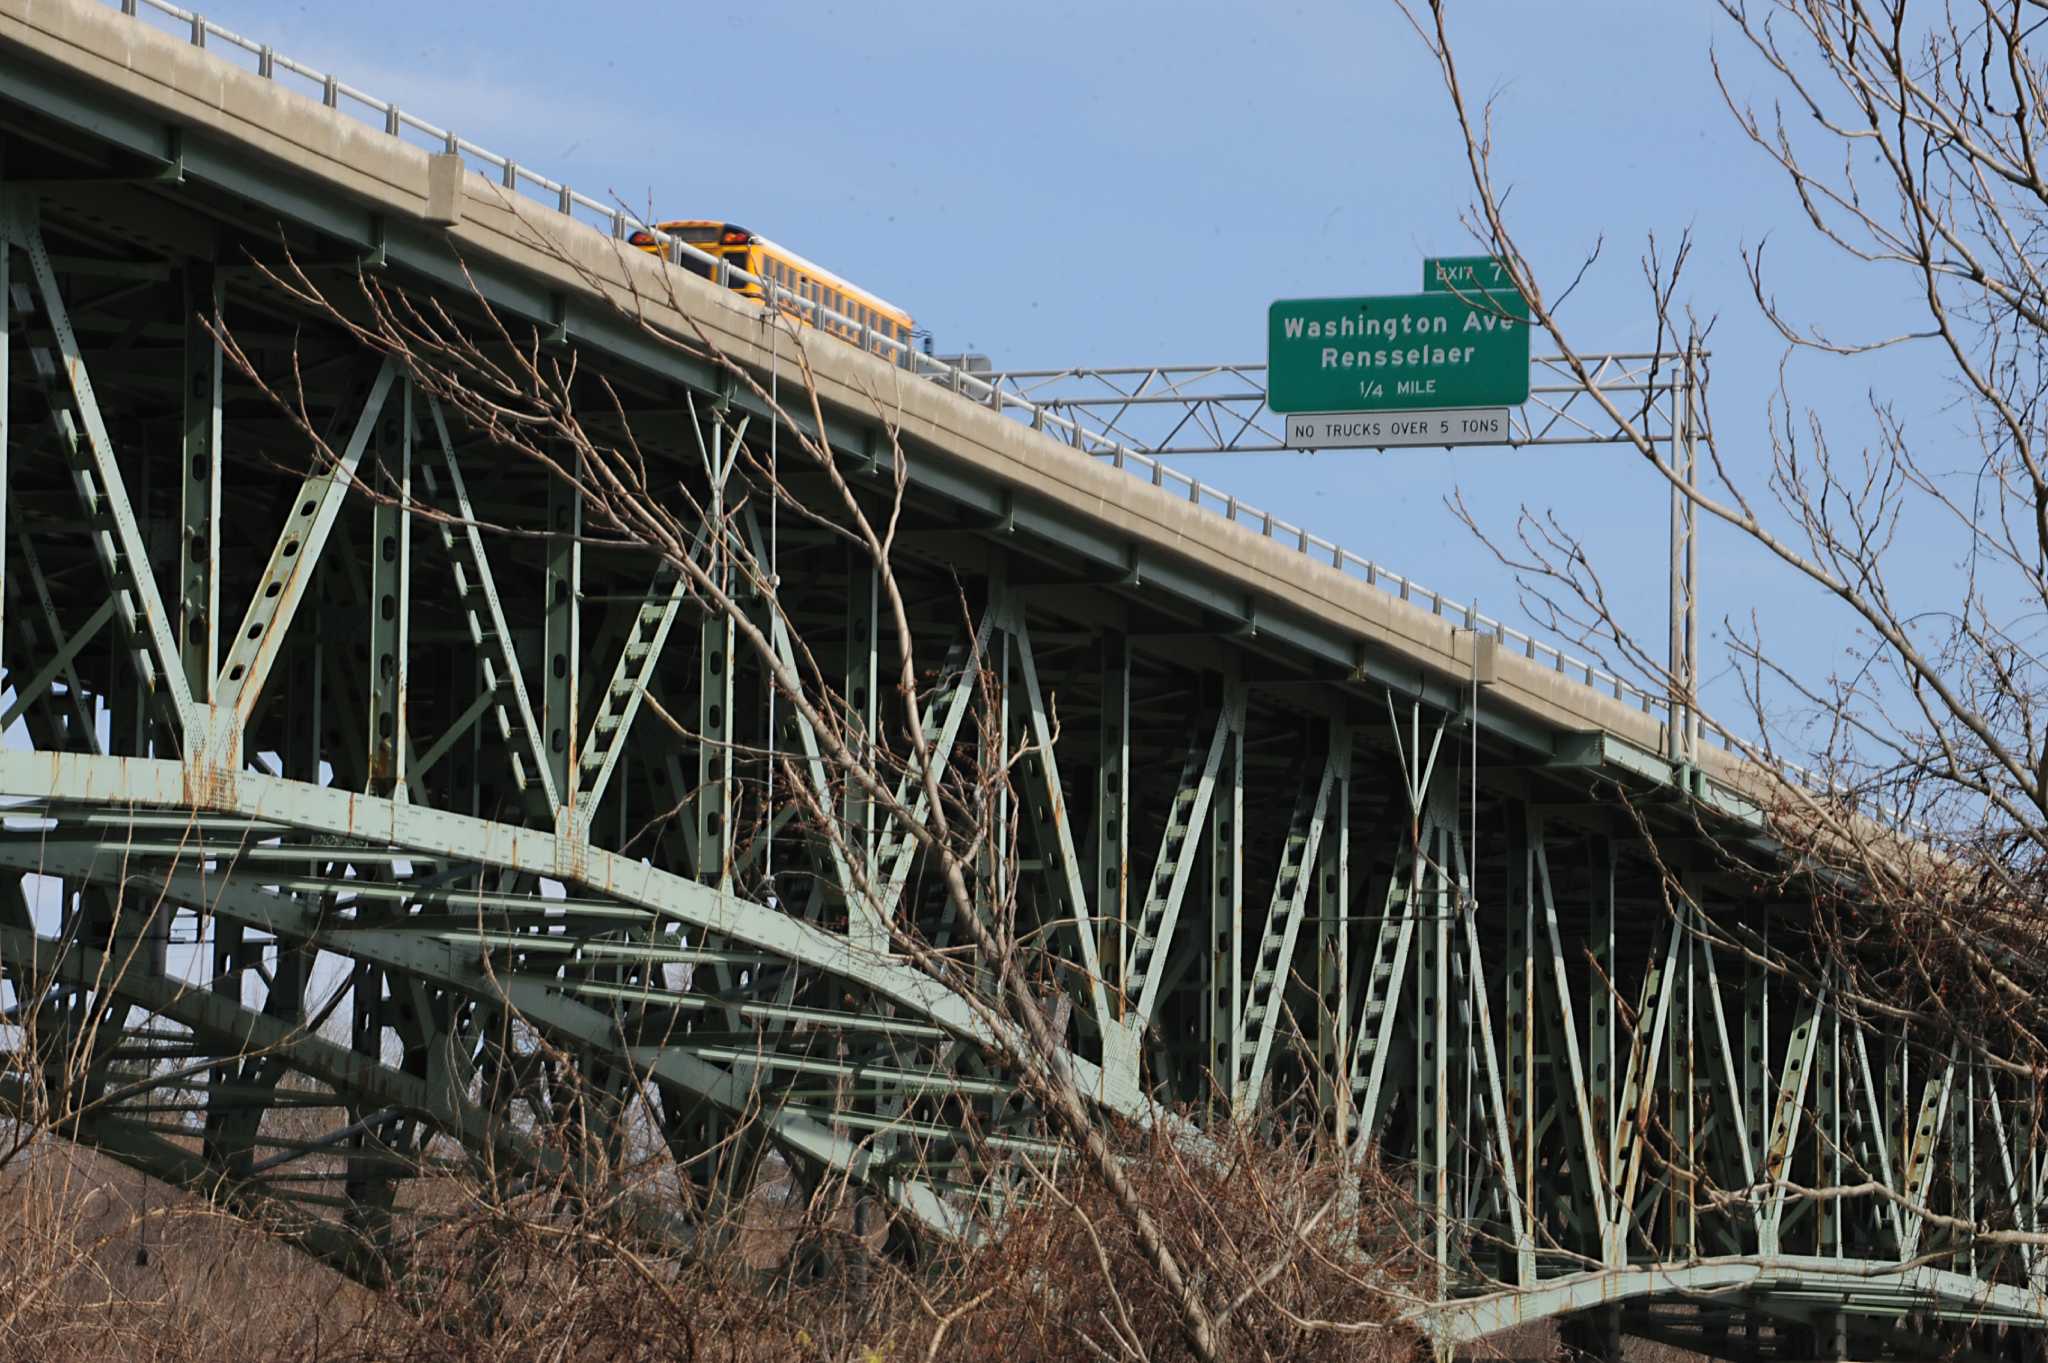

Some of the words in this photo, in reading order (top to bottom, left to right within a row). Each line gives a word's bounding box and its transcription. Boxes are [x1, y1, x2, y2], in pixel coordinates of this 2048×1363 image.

[1437, 266, 1473, 281] EXIT
[1489, 262, 1503, 281] 7
[1285, 314, 1447, 341] Washington
[1463, 311, 1514, 333] Ave
[1321, 345, 1475, 369] Rensselaer
[1360, 380, 1384, 398] 1/4
[1398, 380, 1437, 394] MILE
[1295, 425, 1314, 438] NO
[1325, 424, 1381, 437] TRUCKS
[1391, 422, 1428, 435] OVER
[1440, 421, 1449, 434] 5
[1461, 420, 1498, 433] TONS
